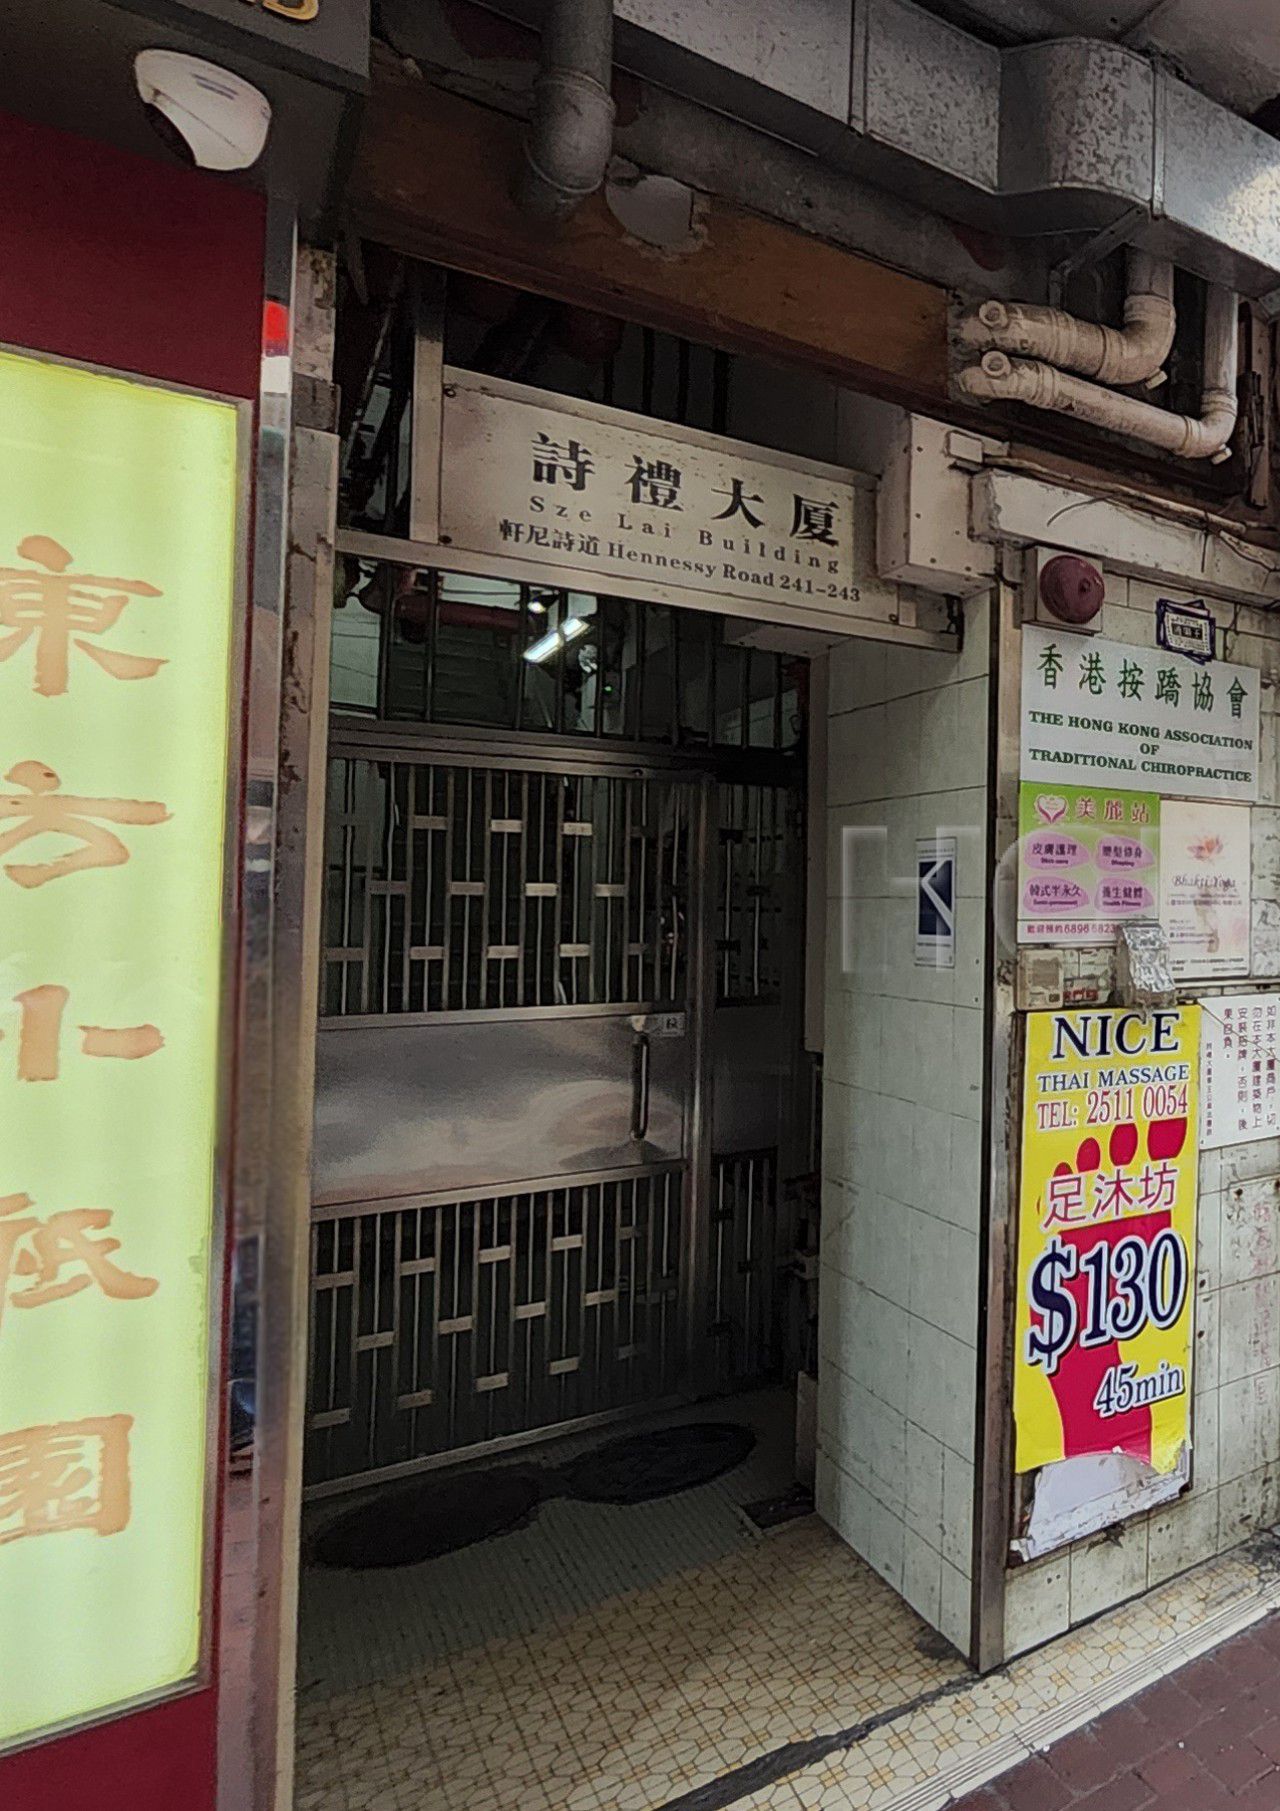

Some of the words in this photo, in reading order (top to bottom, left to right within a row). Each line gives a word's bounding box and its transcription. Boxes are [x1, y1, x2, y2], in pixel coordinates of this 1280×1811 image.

[530, 495, 592, 523] Sze
[617, 512, 672, 539] Lai
[698, 529, 839, 575] Building
[499, 518, 600, 557] 軒尼詩道
[608, 541, 717, 578] Hennessy
[722, 562, 775, 588] Road
[779, 574, 861, 602] 241-243
[1028, 710, 1064, 727] THE
[1067, 715, 1114, 733] HONG
[1117, 721, 1161, 739] KONG
[1163, 728, 1253, 751] ASSOCIATION
[1139, 742, 1160, 756] OF
[1028, 748, 1137, 771] TRADITIONAL
[1140, 760, 1252, 783] CHIROPRACTICE
[1052, 1012, 1180, 1059] NICE
[1037, 1071, 1089, 1093] THAI
[1098, 1064, 1190, 1088] MASSAGE
[1037, 1101, 1078, 1130] TEL:
[1087, 1087, 1134, 1125] 2511
[1143, 1083, 1189, 1118] 0054
[1043, 1161, 1178, 1229] 足沐坊
[1028, 1230, 1185, 1370] $130
[1095, 1363, 1182, 1415] 45min
